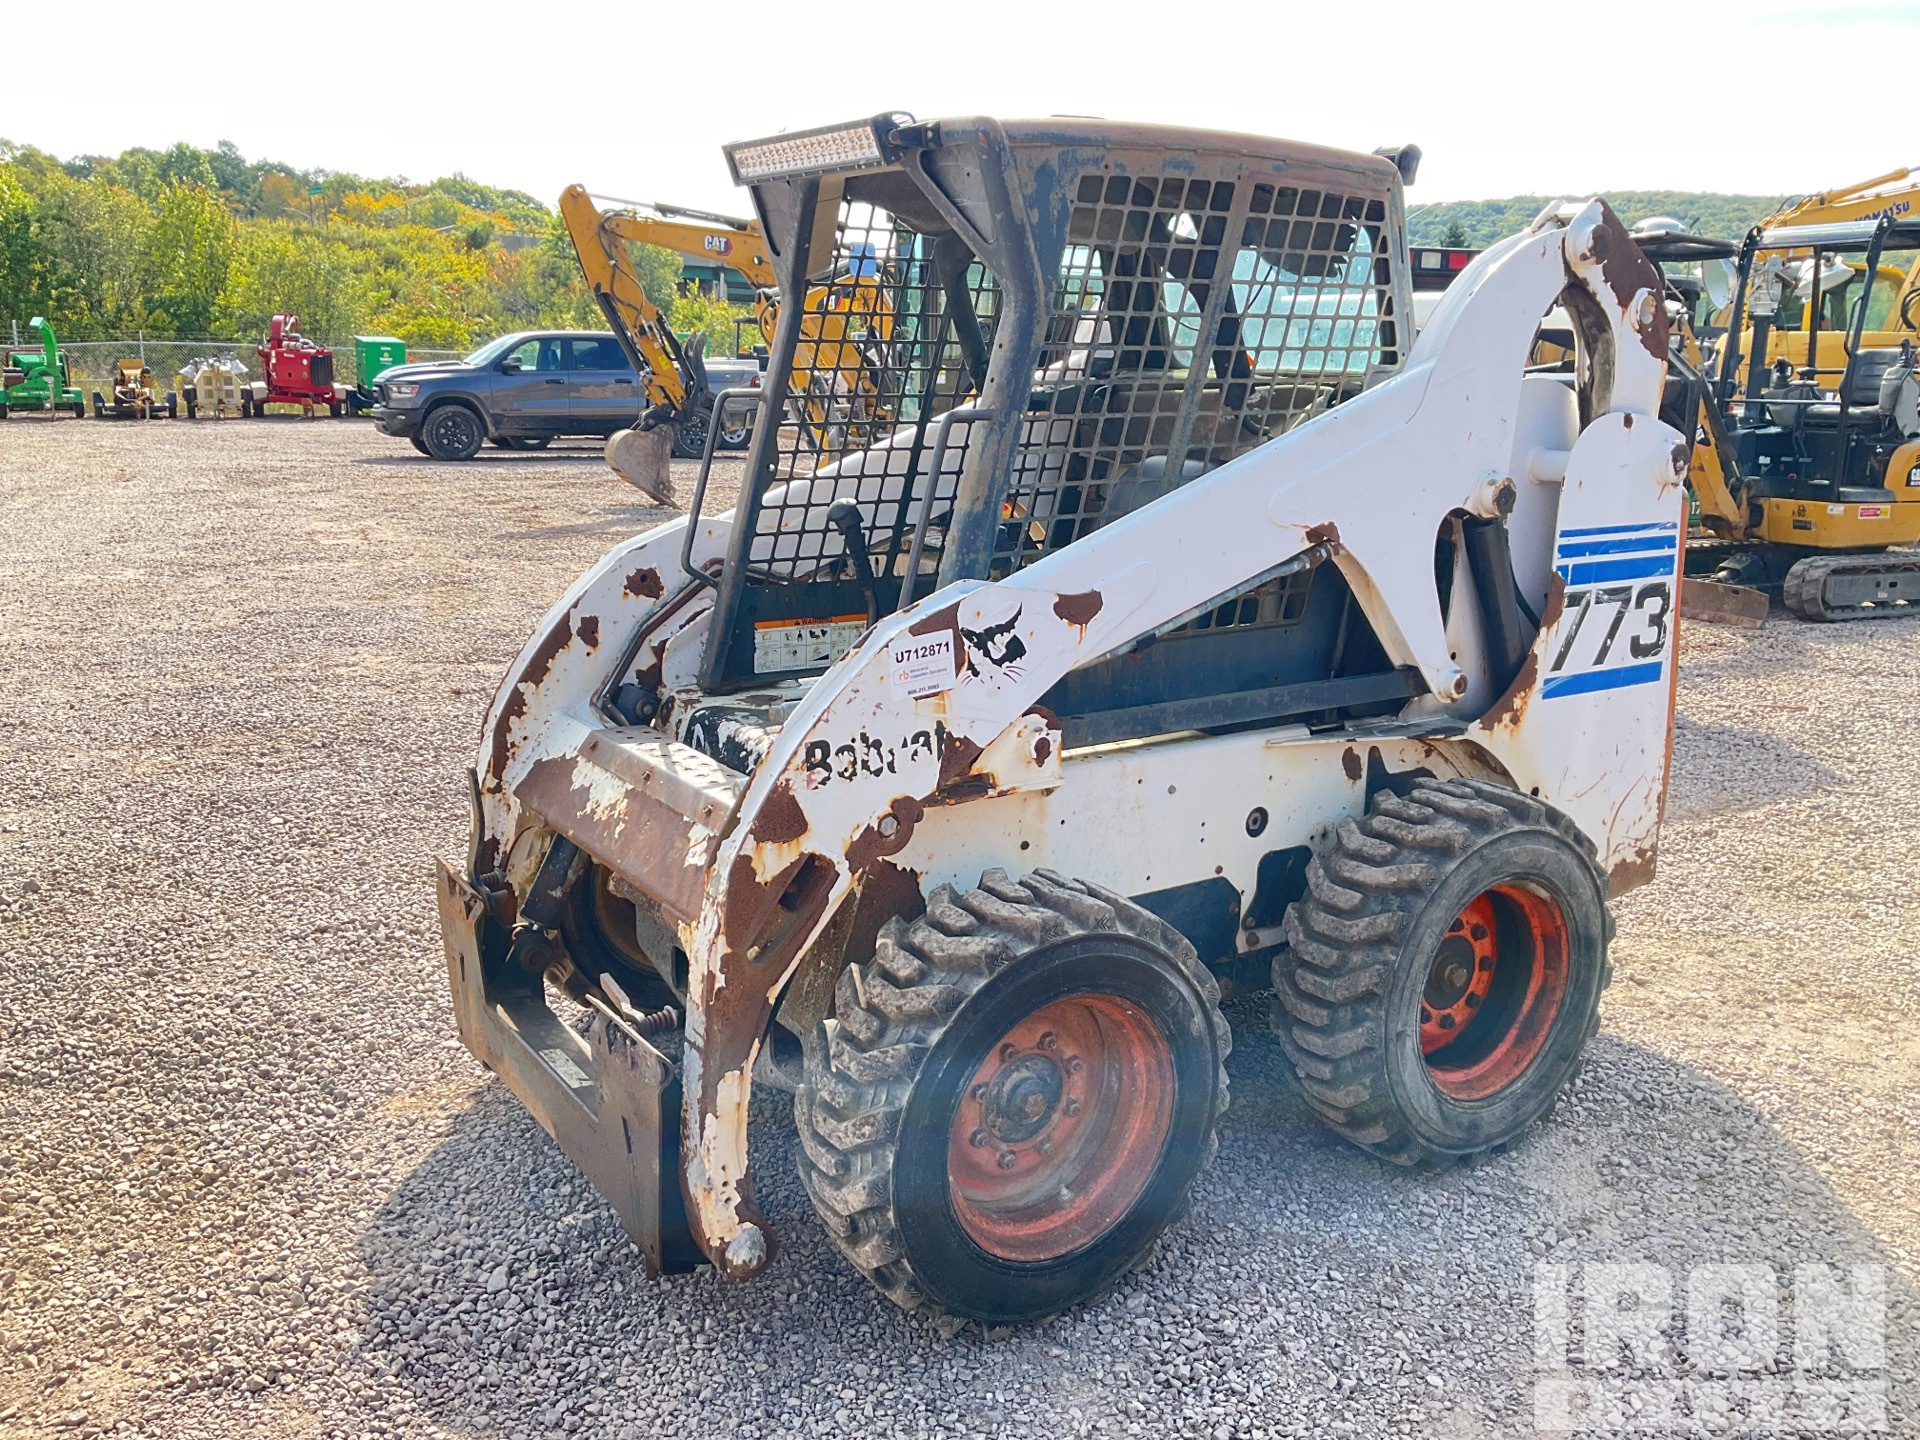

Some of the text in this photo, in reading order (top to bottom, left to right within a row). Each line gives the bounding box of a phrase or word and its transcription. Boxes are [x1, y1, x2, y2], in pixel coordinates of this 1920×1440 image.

[704, 235, 727, 252] CAT
[1550, 581, 1671, 672] 773
[895, 641, 949, 663] U712871
